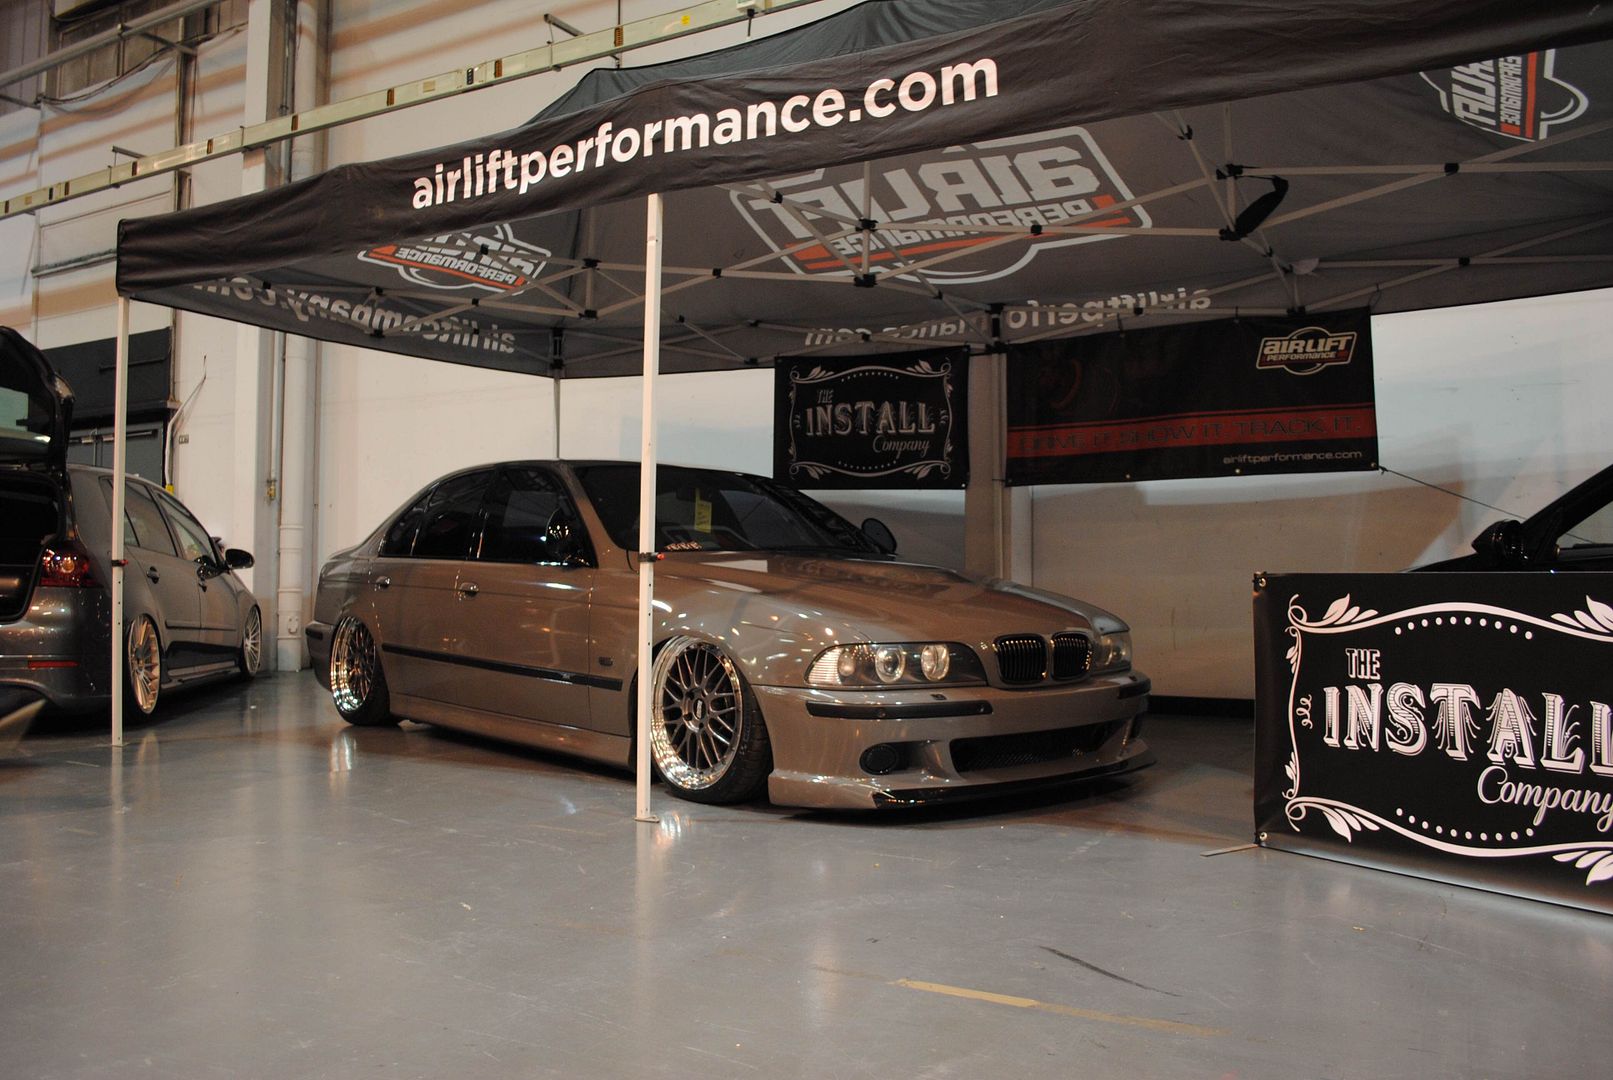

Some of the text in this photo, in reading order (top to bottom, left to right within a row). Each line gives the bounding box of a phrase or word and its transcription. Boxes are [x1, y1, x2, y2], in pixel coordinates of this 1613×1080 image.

[411, 56, 999, 210] airliftperformance.com
[817, 388, 834, 404] THE
[805, 400, 937, 437] INSTALL
[1232, 416, 1327, 435] TRACK
[872, 435, 931, 459] Company
[1222, 449, 1364, 465] airliftperformance.com
[1345, 647, 1381, 680] THE
[1322, 681, 1613, 778] INSTALL
[1476, 765, 1613, 833] Company
